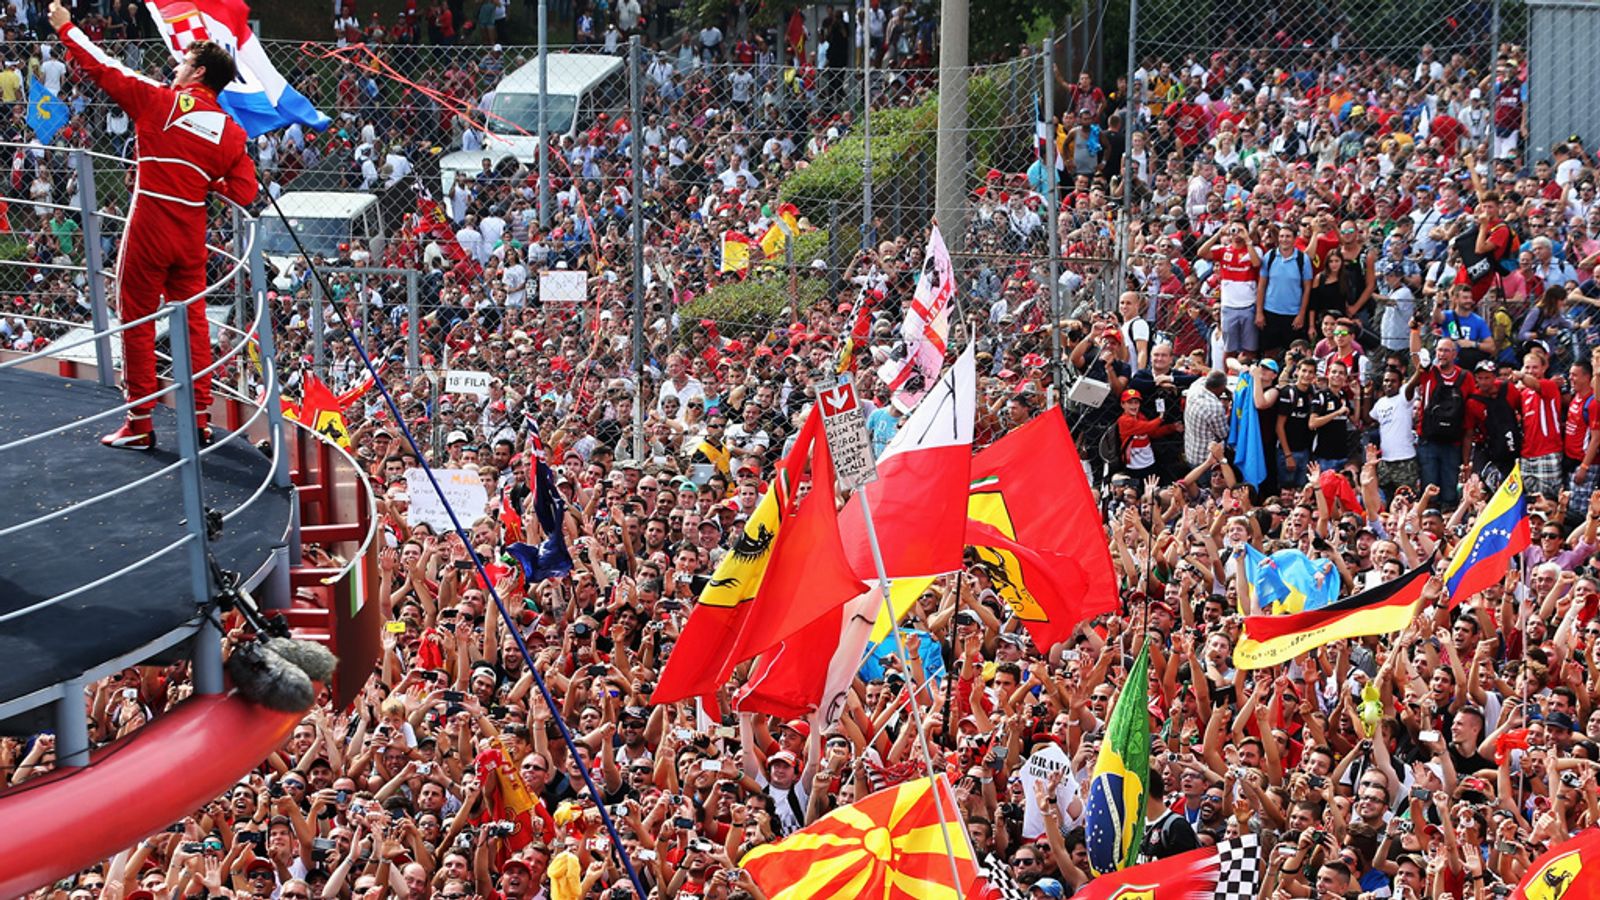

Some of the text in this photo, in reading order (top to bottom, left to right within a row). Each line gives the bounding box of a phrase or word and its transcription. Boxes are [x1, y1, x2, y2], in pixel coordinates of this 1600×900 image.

[464, 376, 487, 388] FILA
[824, 409, 863, 428] PLEASE
[1031, 754, 1070, 775] BRAVO
